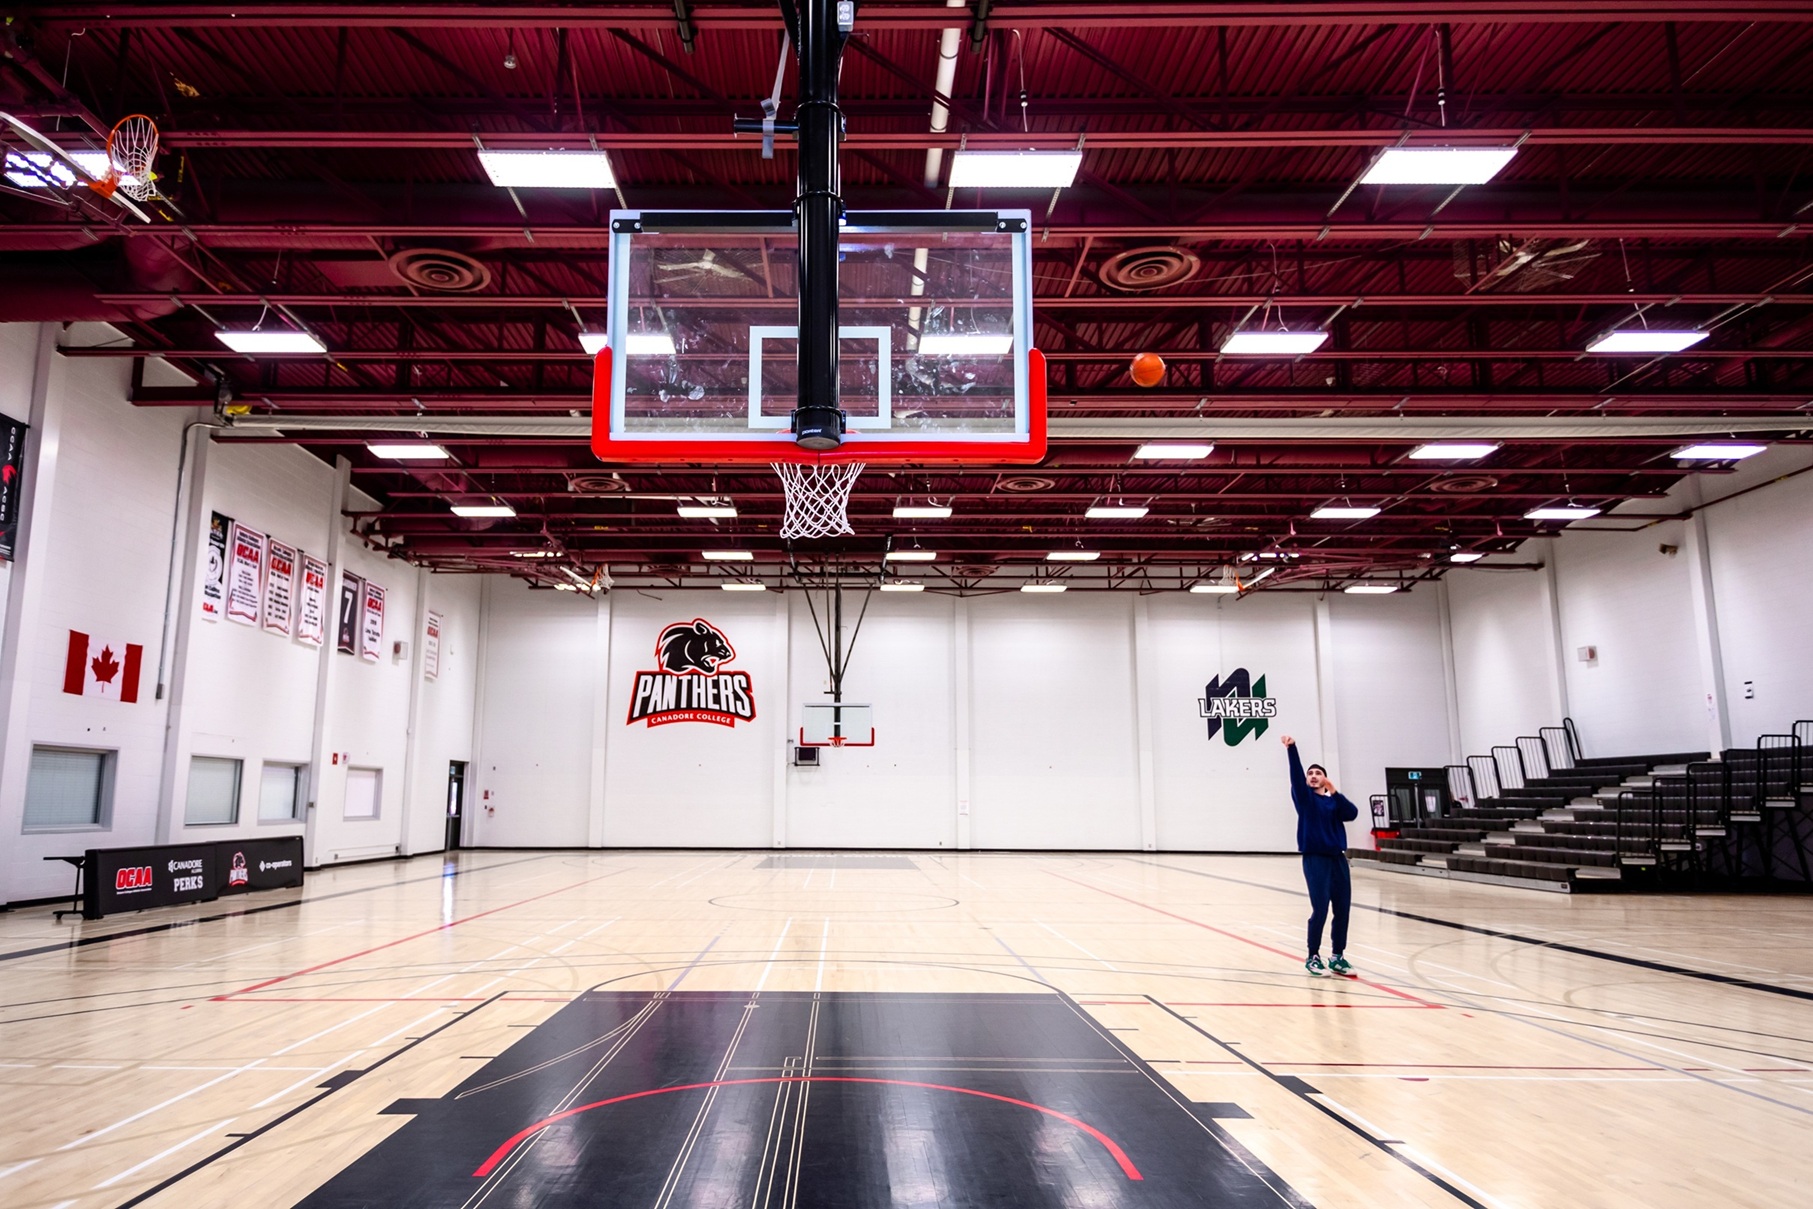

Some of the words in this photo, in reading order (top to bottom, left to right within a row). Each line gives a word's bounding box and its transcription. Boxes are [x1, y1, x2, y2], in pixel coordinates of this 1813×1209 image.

[236, 543, 259, 563] OCAA
[343, 590, 353, 624] 7
[632, 674, 752, 718] PANTHERS
[1198, 698, 1277, 718] LAKERS
[651, 713, 694, 724] CANADORE
[696, 713, 732, 724] COLLEGE
[173, 859, 203, 871] CANADORE
[116, 866, 152, 889] OCAA
[174, 876, 203, 892] PERKS
